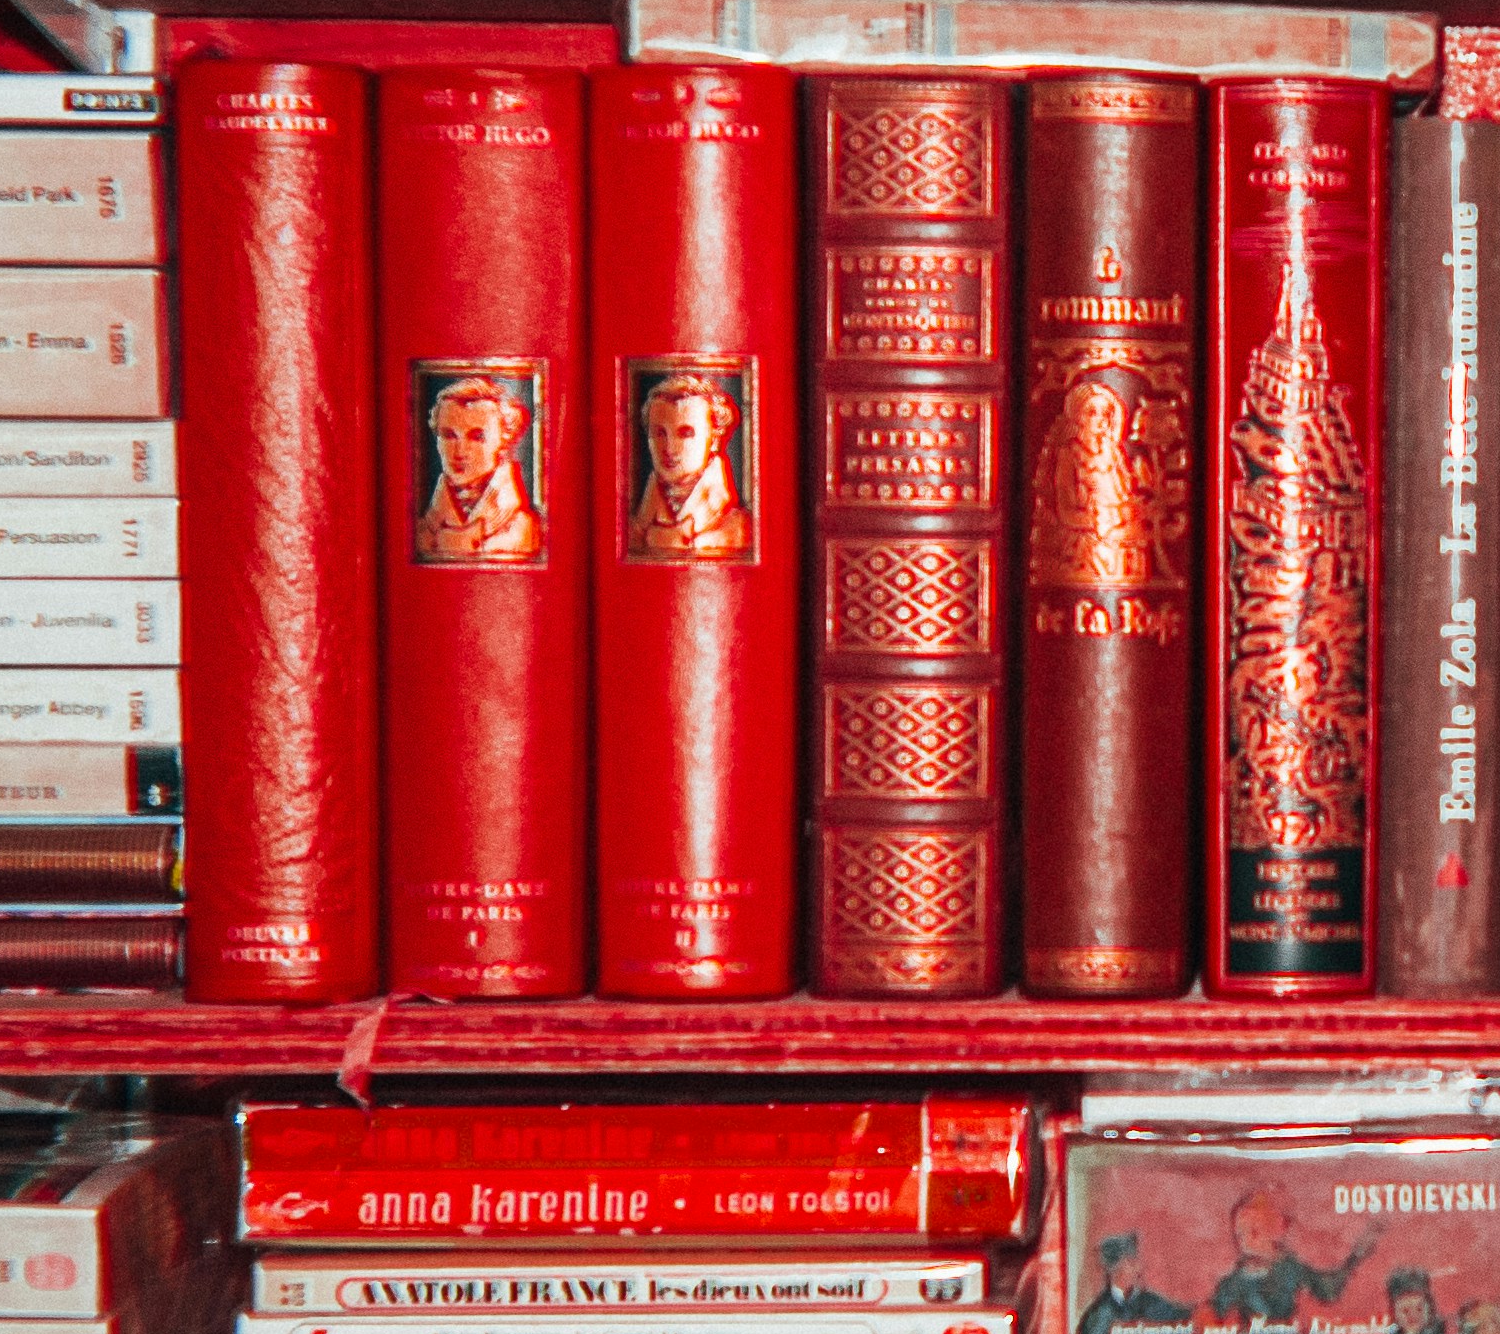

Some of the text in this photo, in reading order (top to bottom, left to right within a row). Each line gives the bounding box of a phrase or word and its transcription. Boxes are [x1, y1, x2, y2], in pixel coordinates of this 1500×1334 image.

[483, 124, 552, 146] HUGO
[856, 429, 968, 447] LETTRES
[846, 457, 974, 475] PERSANES
[1438, 500, 1478, 556] La
[1438, 597, 1478, 824] Emile Zola
[460, 904, 525, 923] PARIS
[358, 1182, 775, 1226] anna karenine LEON
[361, 1280, 503, 1306] ANATOLE
[509, 1278, 637, 1305] FRANCE
